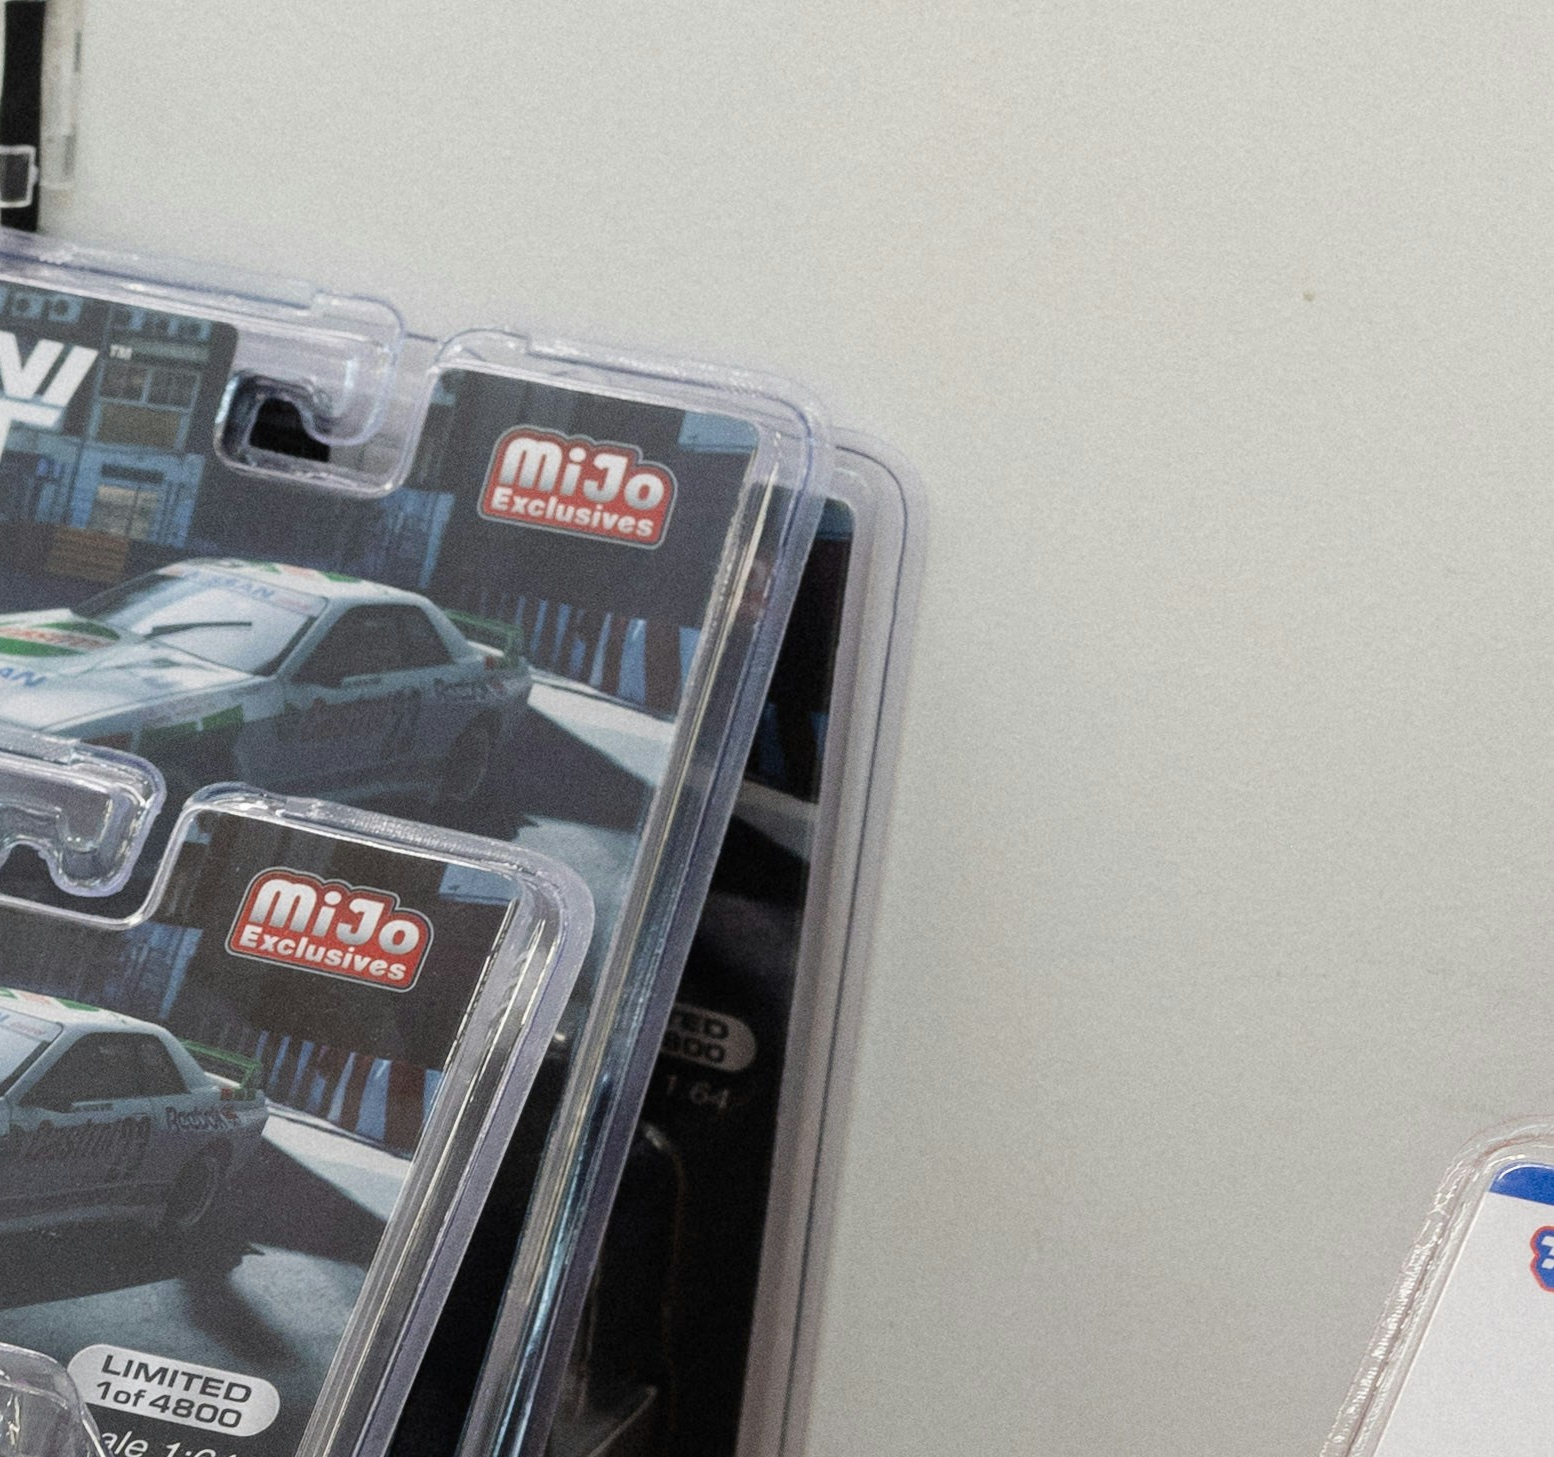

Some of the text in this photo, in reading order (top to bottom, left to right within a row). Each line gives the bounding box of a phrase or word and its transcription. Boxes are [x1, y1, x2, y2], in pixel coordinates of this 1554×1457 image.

[491, 486, 654, 537] Exclusives
[239, 923, 407, 980] Exclusives
[101, 1355, 252, 1403] LIMITED
[149, 1395, 242, 1428] 4800
